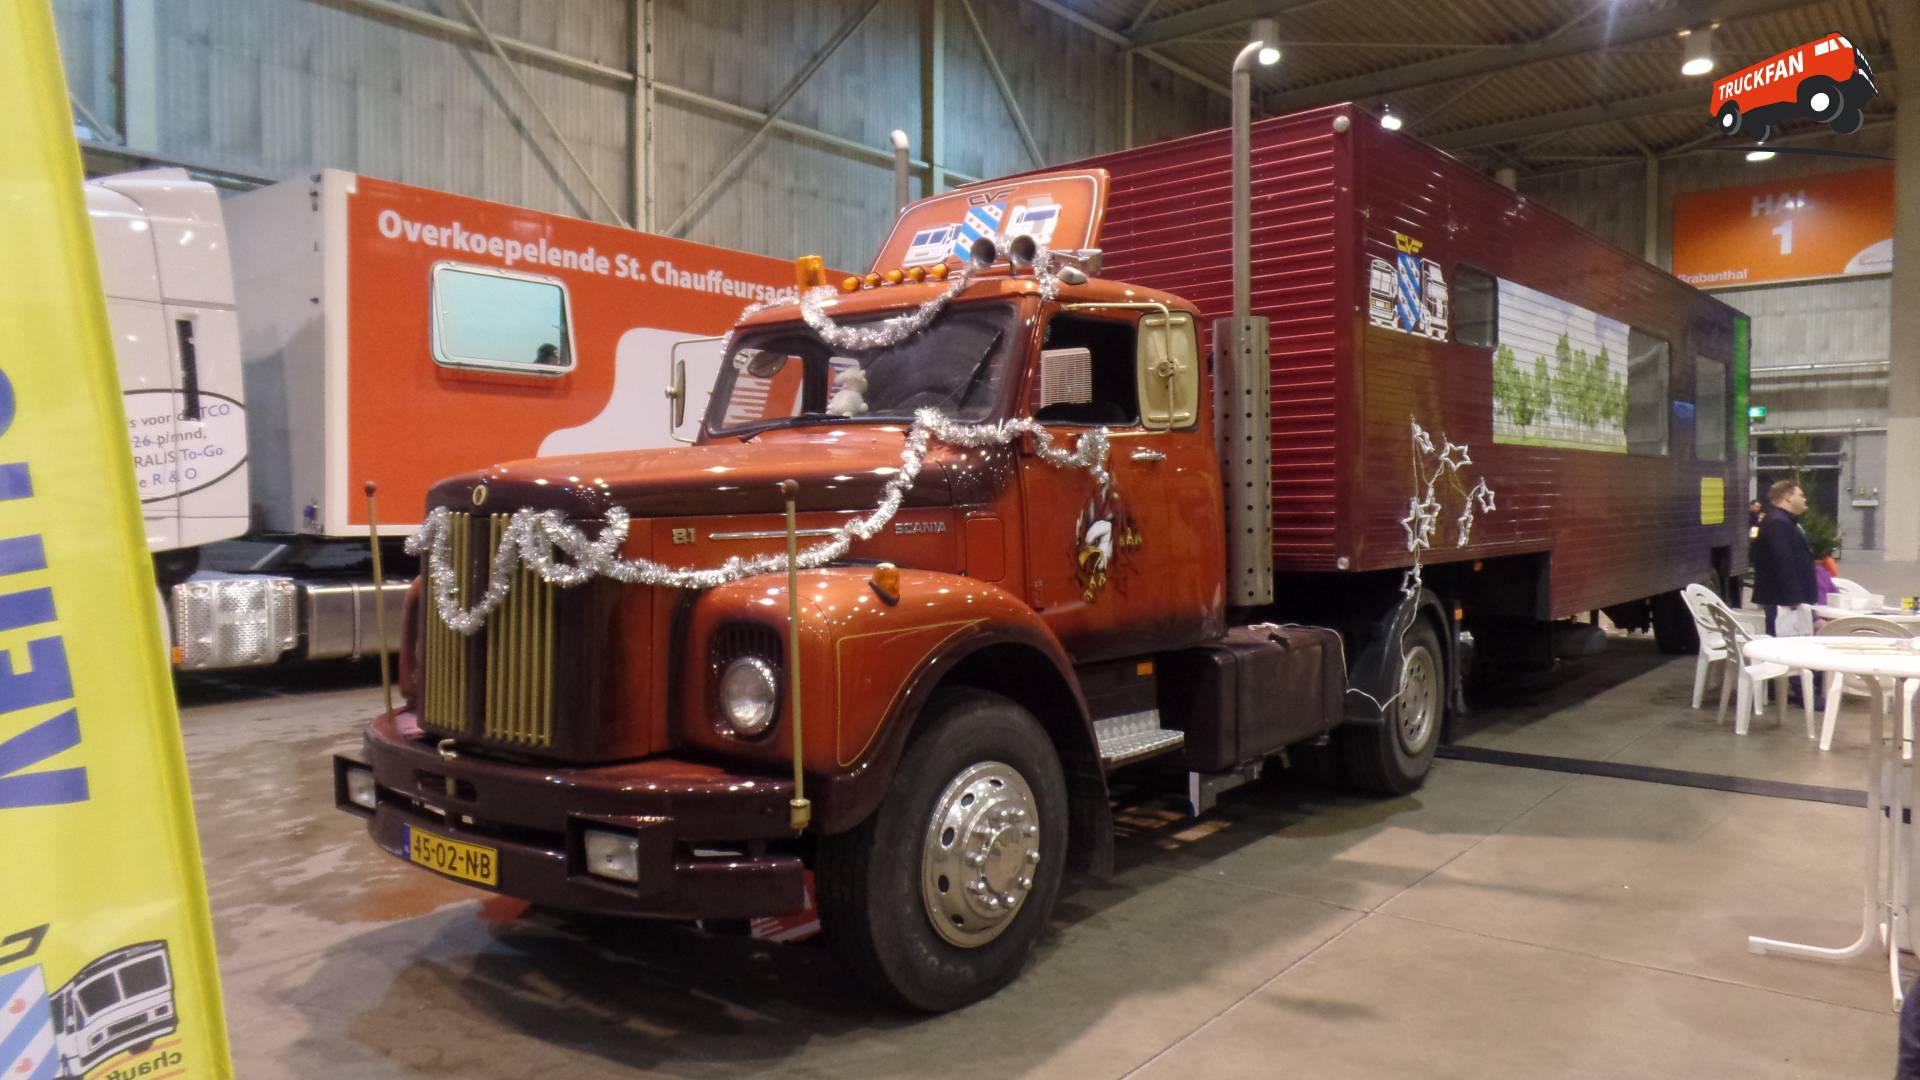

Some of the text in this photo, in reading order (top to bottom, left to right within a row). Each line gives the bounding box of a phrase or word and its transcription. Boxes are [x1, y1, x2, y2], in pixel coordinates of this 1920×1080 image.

[1771, 219, 1793, 256] 1
[377, 209, 800, 302] Overkoepelende St. Chauffeursacti
[141, 414, 171, 426] voor
[134, 445, 224, 468] RALIS To-Go
[152, 473, 162, 485] R
[895, 521, 946, 535] SCANIA
[413, 835, 491, 879] 45-02-NB
